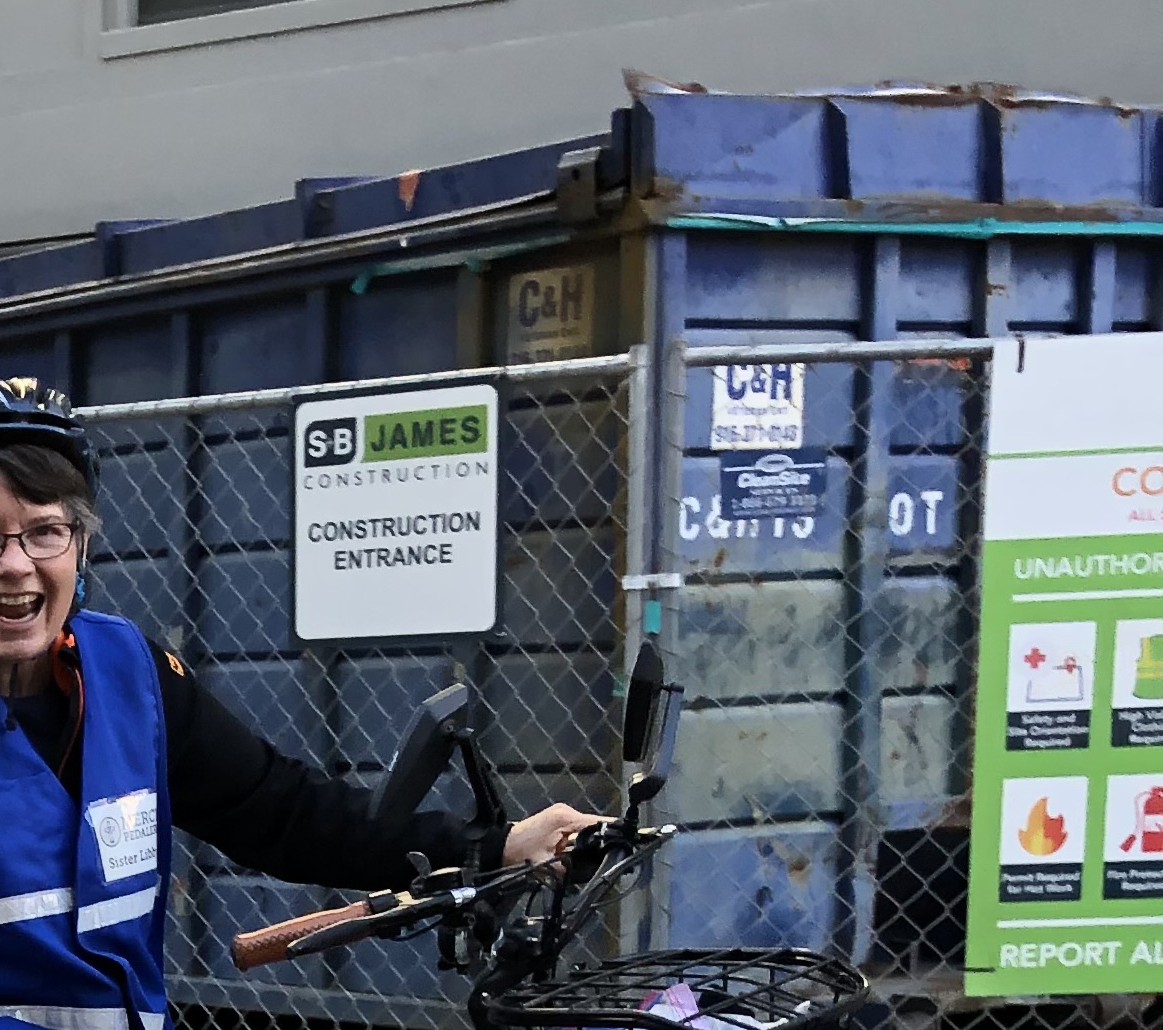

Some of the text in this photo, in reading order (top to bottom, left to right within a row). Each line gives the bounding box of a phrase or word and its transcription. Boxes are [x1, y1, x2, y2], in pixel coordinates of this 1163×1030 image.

[519, 273, 583, 328] C&H
[726, 364, 792, 400] C&H
[370, 415, 481, 453] JAMES
[303, 461, 489, 491] CONSTRUCTION
[1111, 466, 1163, 497] CO
[307, 511, 481, 543] CONSTRUCTION
[334, 544, 453, 570] ENTRANCE
[1013, 552, 1163, 580] UNAUTHOR
[108, 850, 138, 870] Sister
[999, 941, 1123, 969] REPORT
